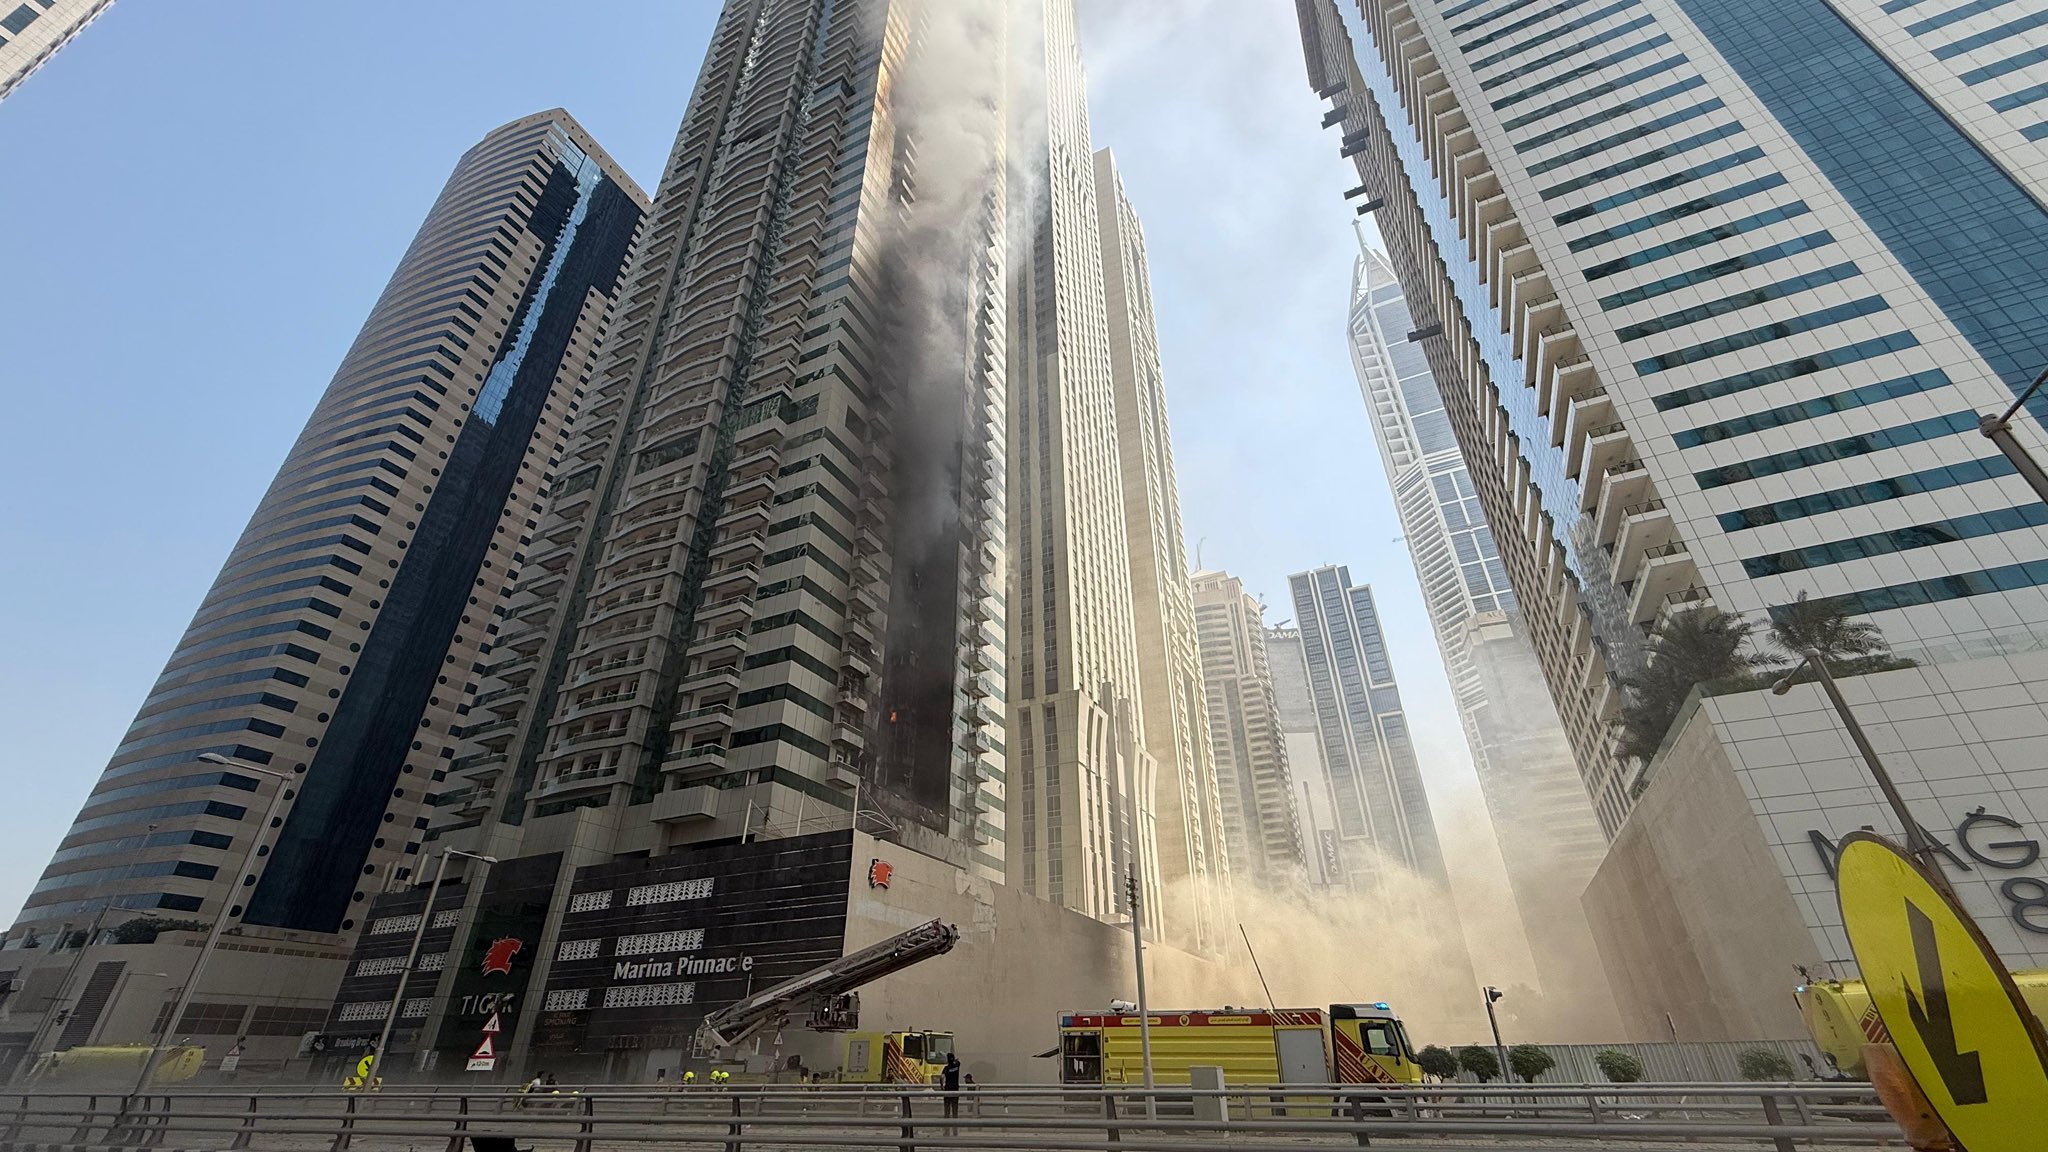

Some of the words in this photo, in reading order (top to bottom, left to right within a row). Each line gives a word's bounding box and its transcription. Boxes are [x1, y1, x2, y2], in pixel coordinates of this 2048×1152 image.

[1268, 631, 1300, 639] DAMA
[1324, 832, 1338, 874] DAMAC
[613, 958, 672, 980] Marina
[677, 952, 754, 976] Pinnacle
